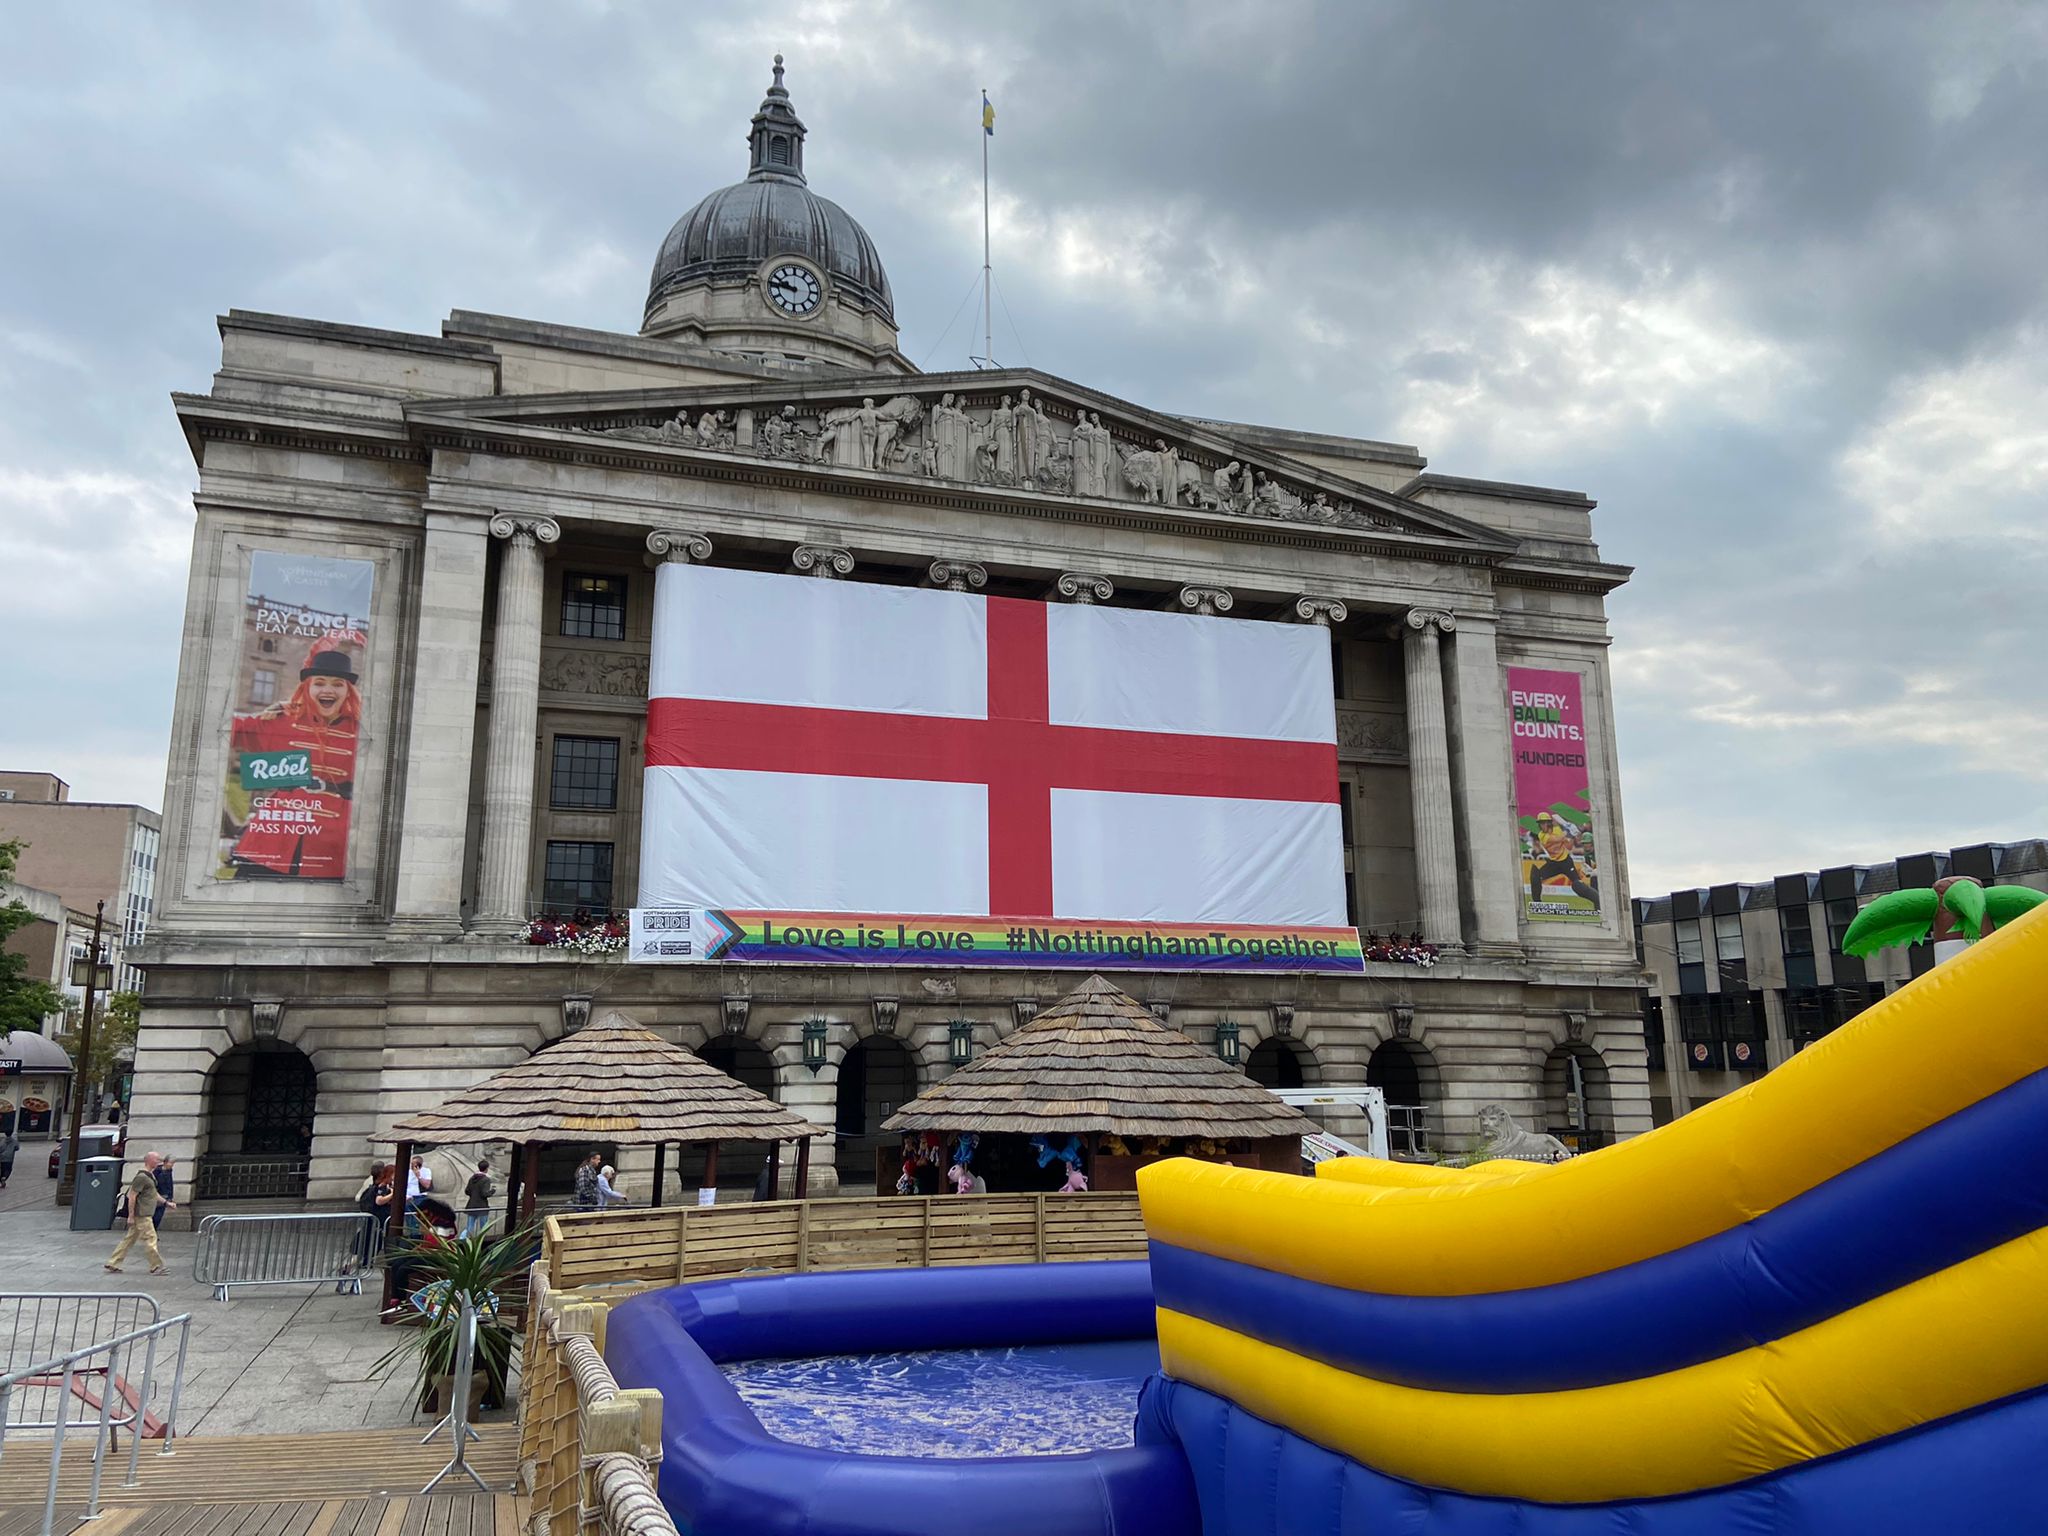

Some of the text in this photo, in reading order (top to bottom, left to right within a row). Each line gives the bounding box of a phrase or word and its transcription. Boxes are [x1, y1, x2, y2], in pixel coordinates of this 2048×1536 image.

[256, 609, 359, 630] PAY ONCE
[255, 623, 357, 640] PLAY ALL YEAR
[1511, 690, 1569, 710] EVERY.
[1514, 721, 1583, 741] COUNTS.
[249, 756, 309, 780] Rebel
[1516, 751, 1585, 768] HUNDRED
[253, 797, 322, 810] GET YOUR
[258, 809, 316, 823] REBEL
[249, 822, 322, 835] PASS NOW
[644, 916, 690, 929] PRIDE
[763, 920, 1338, 960] Love is Love #NottinghamTogether
